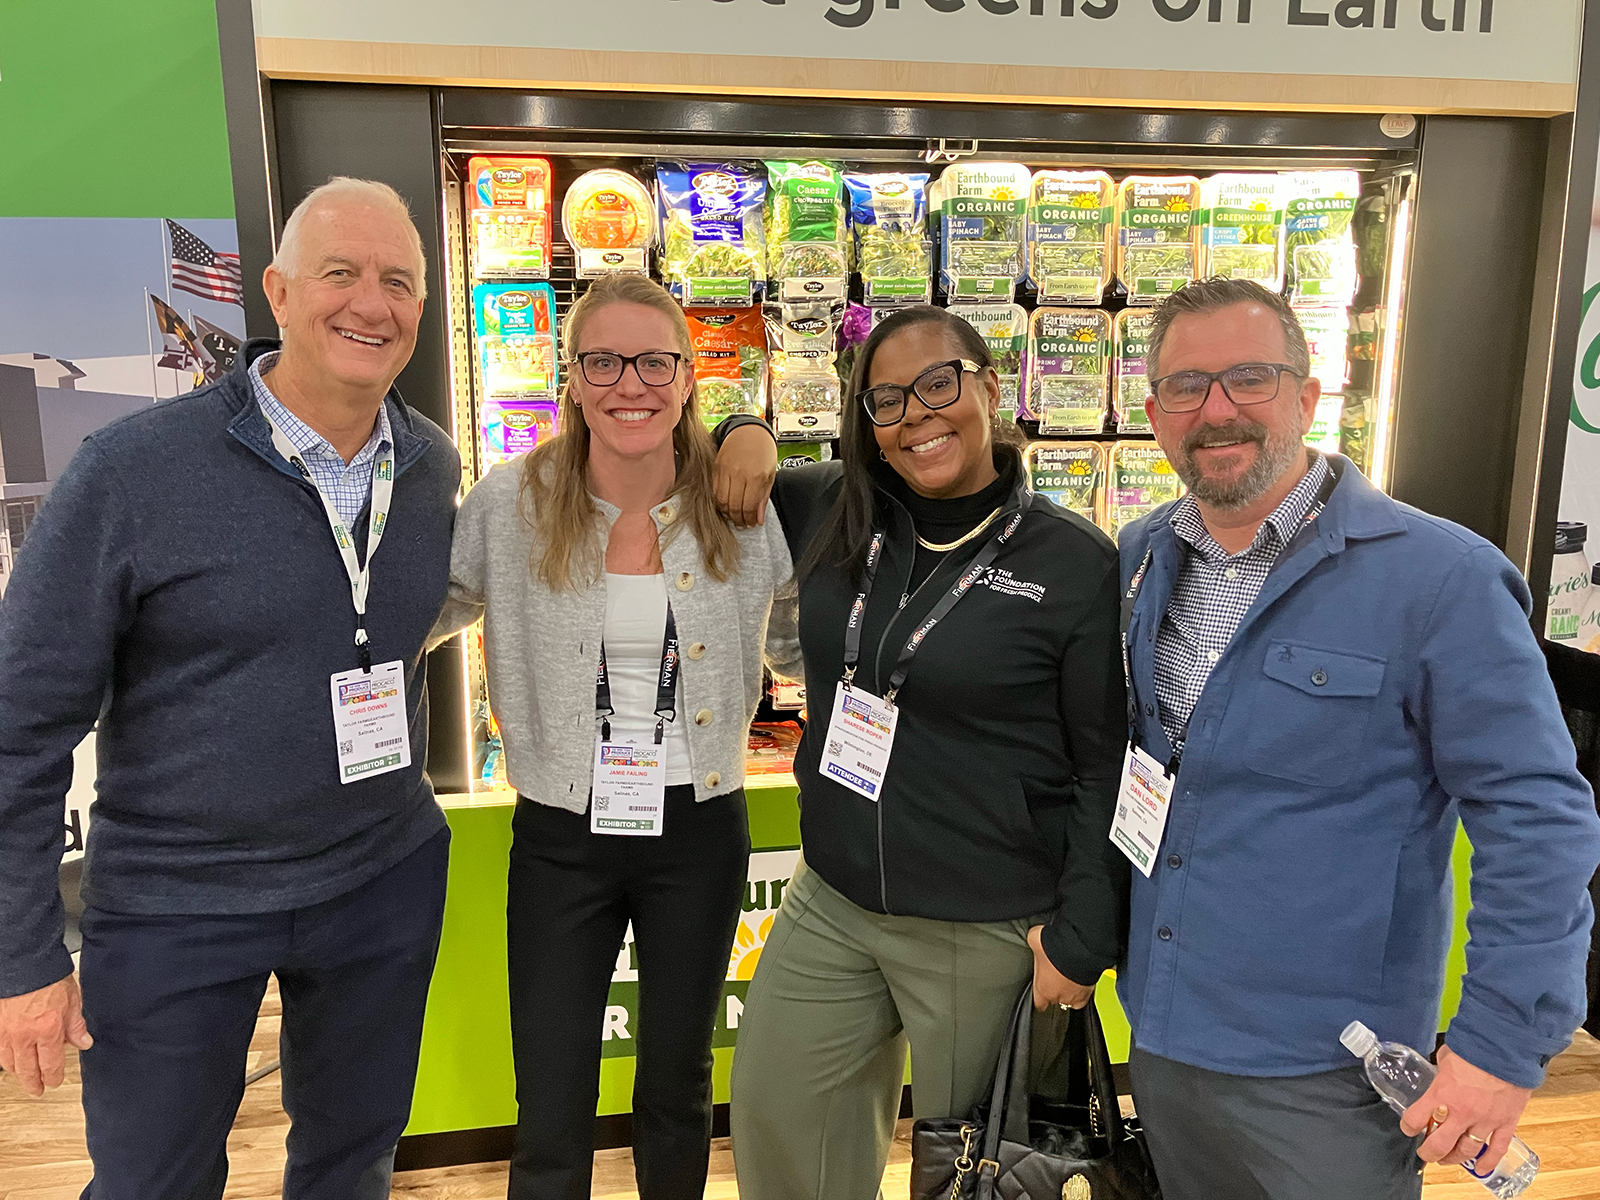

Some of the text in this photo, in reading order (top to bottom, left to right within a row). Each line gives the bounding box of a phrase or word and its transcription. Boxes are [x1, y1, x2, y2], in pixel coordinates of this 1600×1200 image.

[496, 171, 522, 180] Taylor
[957, 171, 1016, 184] Earthbound
[797, 184, 830, 195] Caesar
[957, 185, 983, 196] Farm
[1043, 179, 1101, 192] Earthbound
[1134, 183, 1190, 195] Earthbound
[1219, 183, 1274, 194] Earthbound
[1043, 192, 1070, 202] Farm
[1134, 196, 1160, 207] Farm
[1218, 194, 1242, 205] Farm
[880, 199, 908, 207] Broccoli
[956, 202, 1016, 213] ORGANIC
[1296, 200, 1352, 211] ORGANIC
[1042, 209, 1100, 221] ORGANIC
[1132, 214, 1189, 224] ORGANIC
[1216, 213, 1272, 222] GREENHOUSE
[502, 295, 527, 303] Taylor
[1043, 313, 1099, 326] Earthbound
[791, 321, 824, 330] Taylor
[1042, 325, 1069, 337] Farm
[694, 337, 735, 349] Caesar
[1040, 342, 1097, 354] ORGANIC
[506, 414, 532, 422] Taylor
[1038, 449, 1092, 460] Earthbound
[1123, 447, 1167, 458] Earthbou
[783, 458, 813, 467] Taylo
[1038, 460, 1063, 471] Farm
[1122, 459, 1147, 469] Farm
[1036, 476, 1091, 486] ORGANIC
[1121, 475, 1174, 485] ORGANIC
[997, 513, 1022, 544] FIERMAN
[866, 533, 882, 567] FIERMAN
[998, 568, 1013, 578] THE
[1126, 549, 1151, 598] FIERMAN
[952, 564, 984, 597] FIERMAN
[994, 575, 1046, 594] FOUNDATION
[1549, 572, 1589, 597] arie's
[989, 584, 1042, 603] FOR FRESH PRODUCE
[849, 593, 865, 629] FIERMAN
[1551, 608, 1572, 616] CREAMY
[1550, 615, 1580, 634] RANC
[907, 618, 937, 651] FIERMAN
[661, 638, 678, 687] FIERMAN
[349, 703, 388, 716] CHRIS DOWNS
[843, 718, 883, 741] SHARESE ROPER
[347, 759, 385, 775] EXHIBITOR
[828, 764, 863, 785] ATTENDEE
[1130, 783, 1142, 798] DAN
[1142, 794, 1158, 812] LORD
[599, 819, 637, 829] EXHIBITOR
